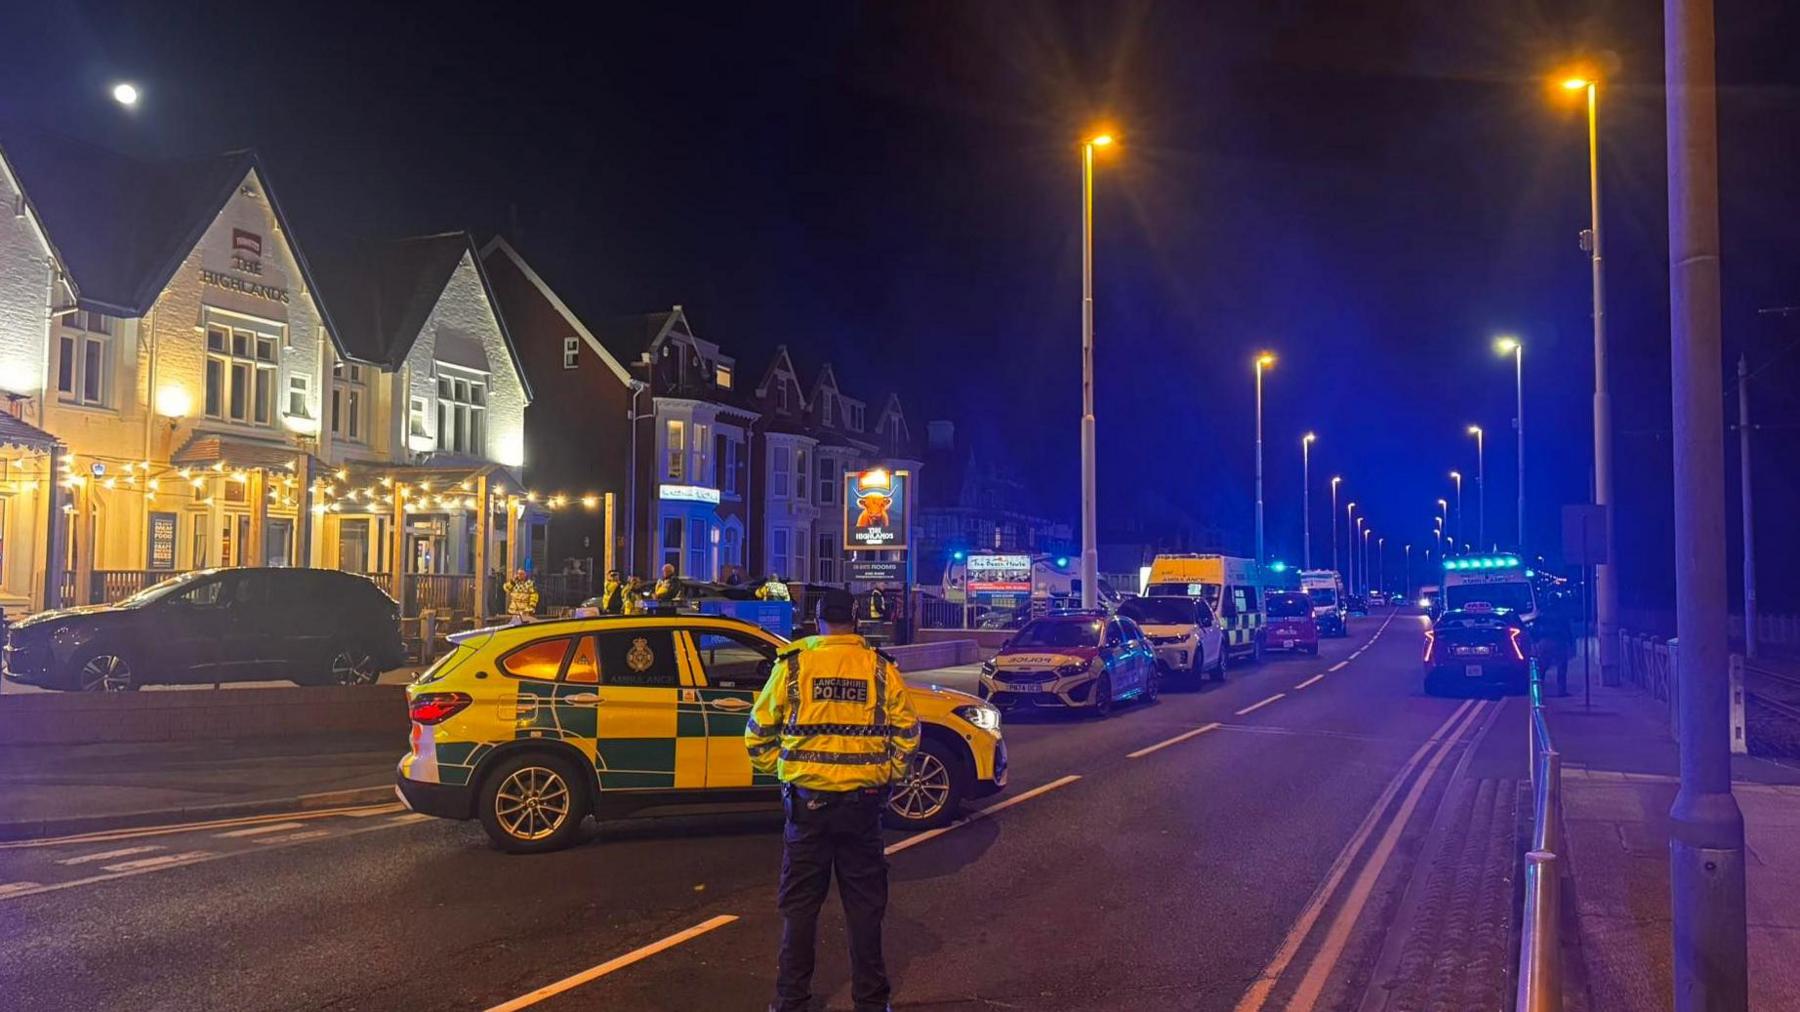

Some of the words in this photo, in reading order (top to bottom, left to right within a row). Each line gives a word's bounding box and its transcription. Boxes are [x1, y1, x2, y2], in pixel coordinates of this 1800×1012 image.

[231, 256, 263, 276] THE
[199, 269, 290, 304] HIGHLANDS
[855, 532, 894, 541] HIGHLANDS
[814, 678, 866, 688] LANCASHIRE
[814, 687, 867, 700] POLICE
